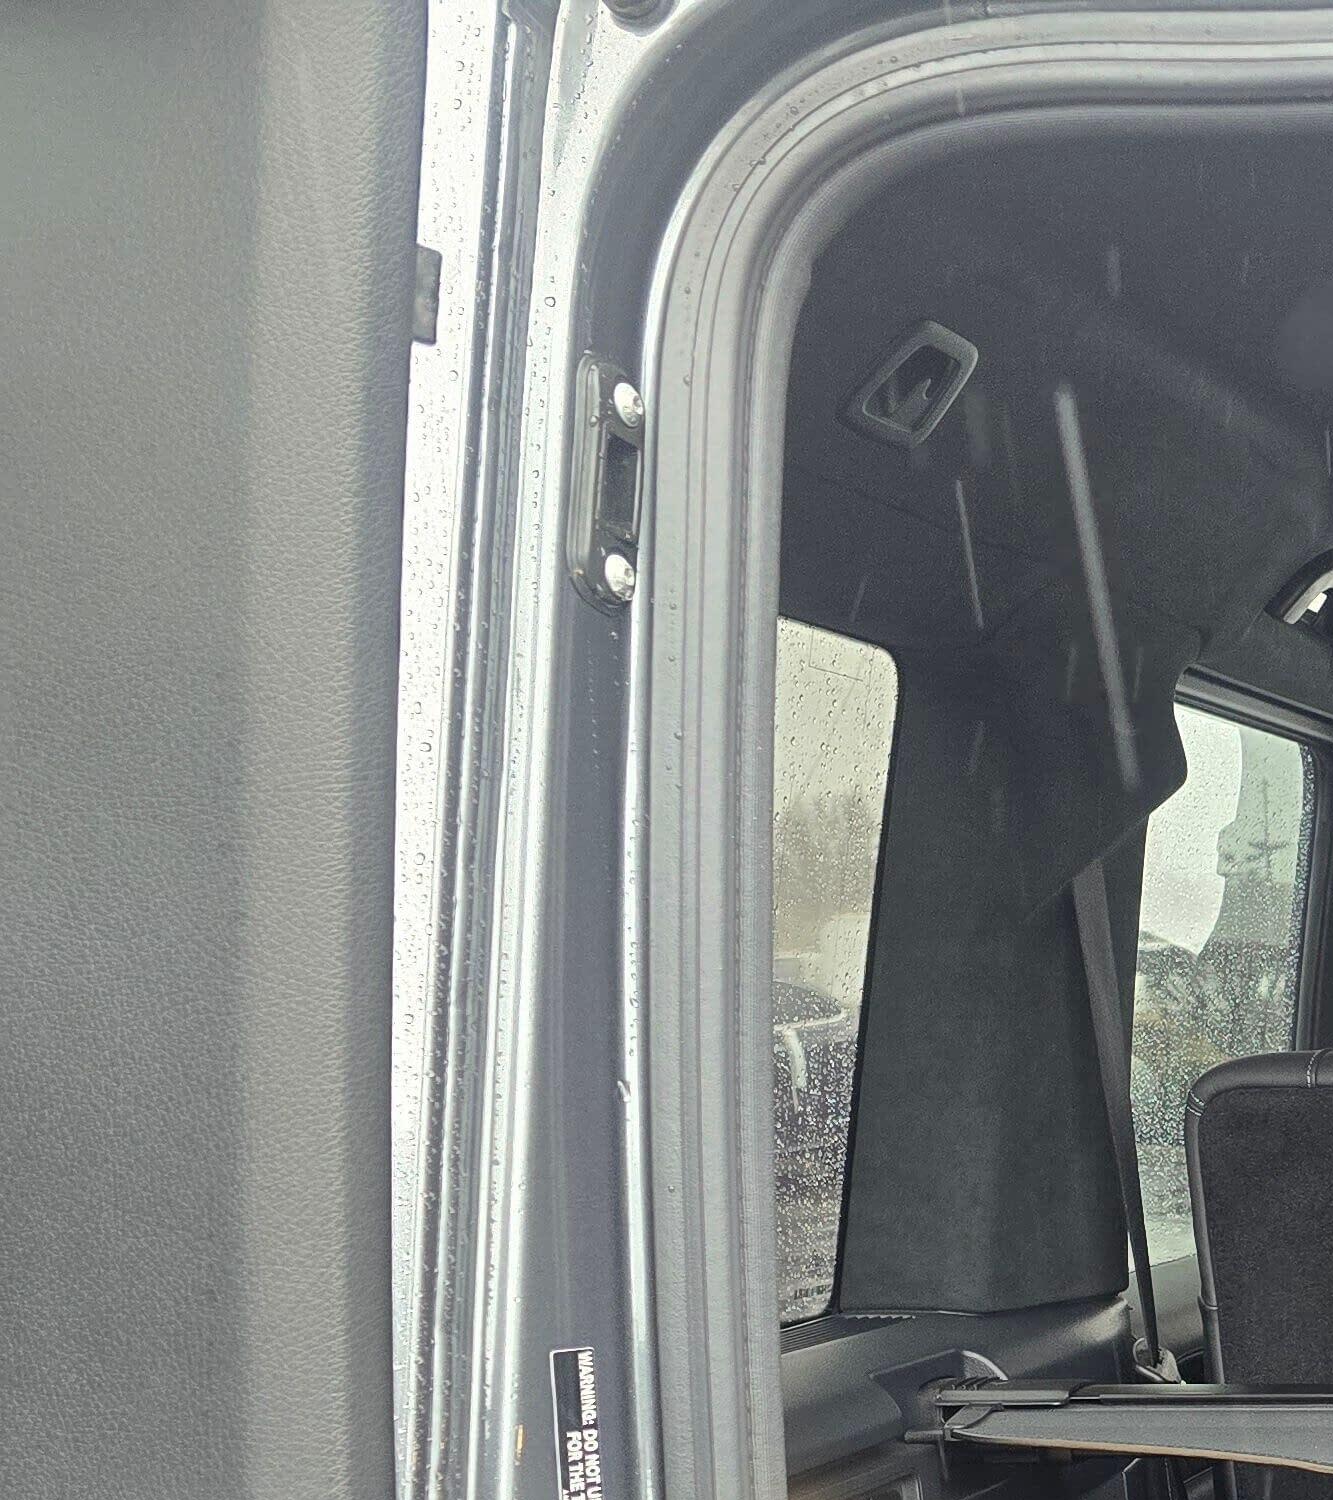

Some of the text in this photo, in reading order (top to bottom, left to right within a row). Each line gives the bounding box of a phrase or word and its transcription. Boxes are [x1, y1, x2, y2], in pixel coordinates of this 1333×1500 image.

[578, 1351, 596, 1426] WARNING:
[566, 1431, 582, 1462] FOR
[582, 1429, 598, 1452] DO
[568, 1462, 584, 1492] THE
[584, 1454, 600, 1484] NOT
